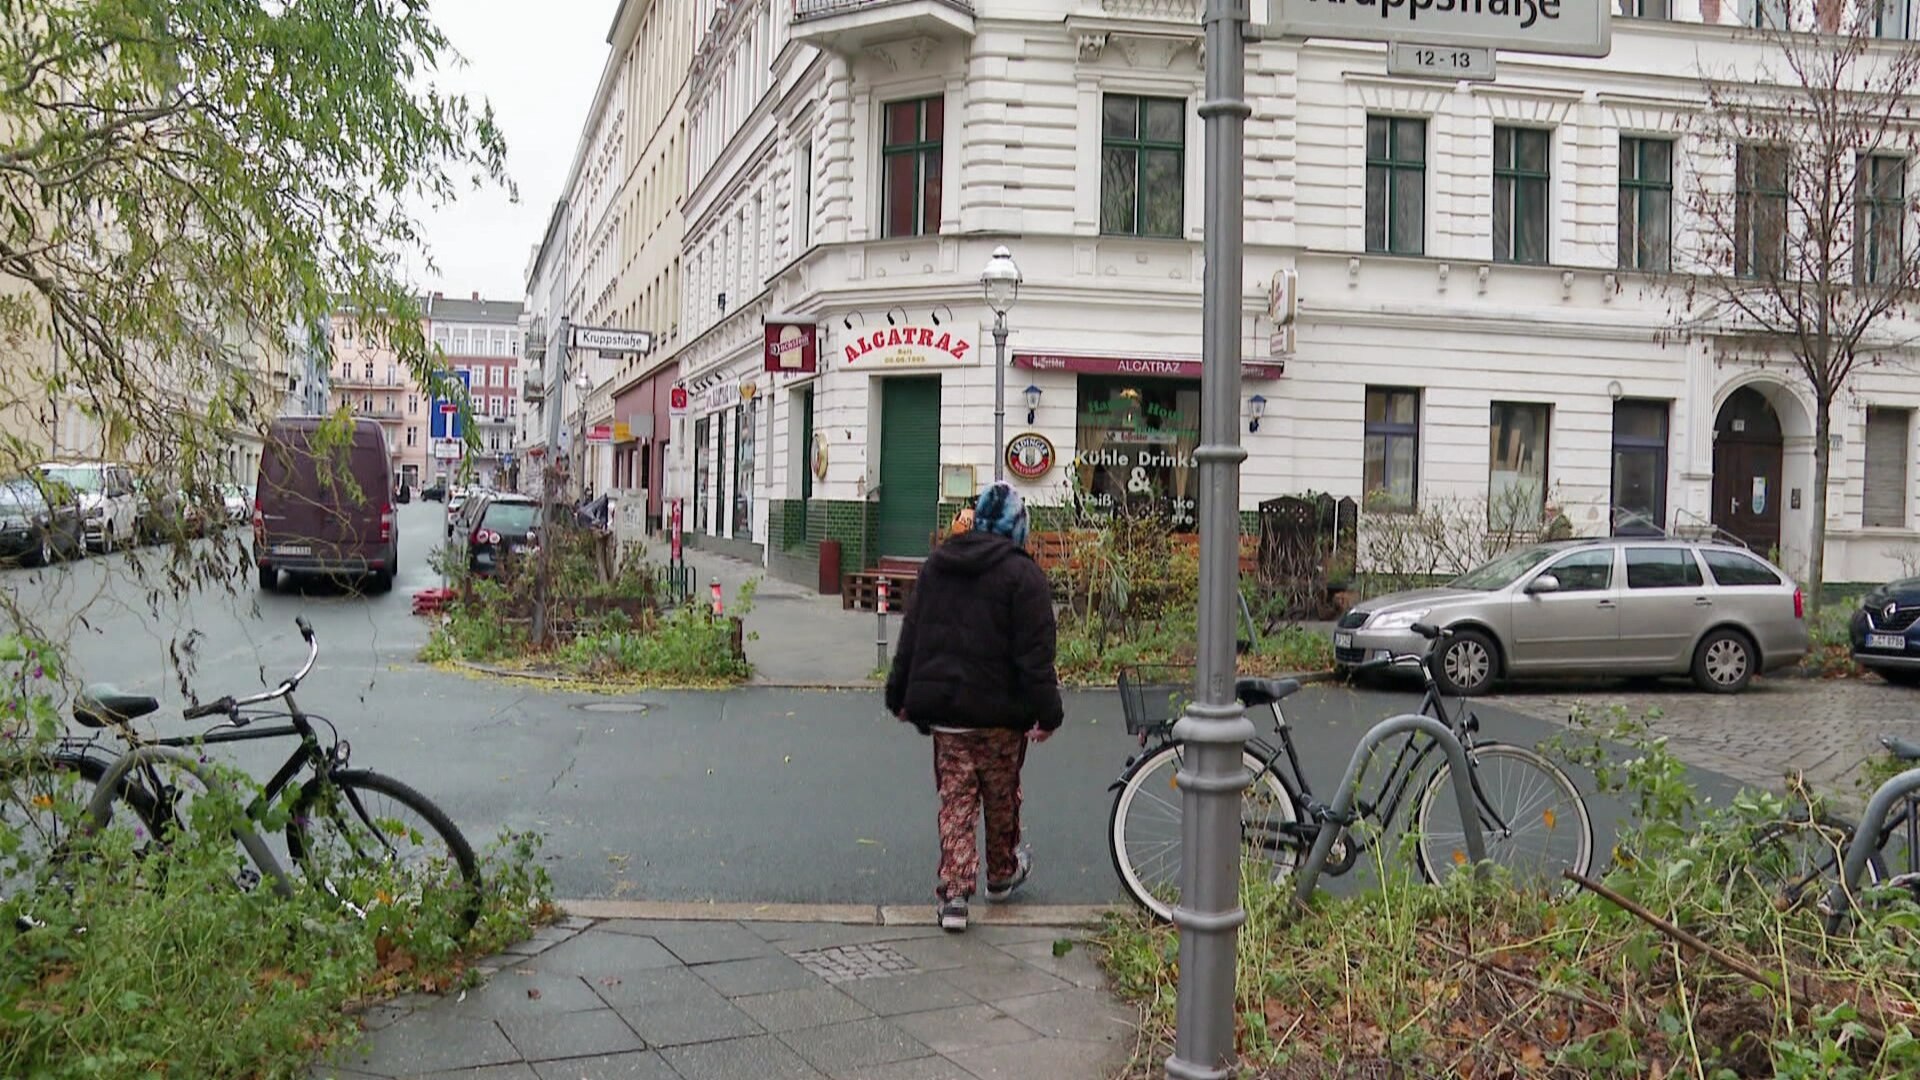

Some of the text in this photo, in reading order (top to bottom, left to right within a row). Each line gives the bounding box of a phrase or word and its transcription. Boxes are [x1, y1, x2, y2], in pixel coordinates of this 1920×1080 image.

[1307, 0, 1560, 28] ppraße
[1415, 50, 1435, 66] 12
[1450, 52, 1470, 68] 13
[583, 331, 642, 348] Kruppstraße
[844, 327, 970, 364] ALCATRAZ
[1117, 360, 1181, 373] ALCATRAZ
[1012, 438, 1048, 454] ERDINGER
[1080, 448, 1199, 467] Kühle Drinks
[1128, 466, 1152, 492] &
